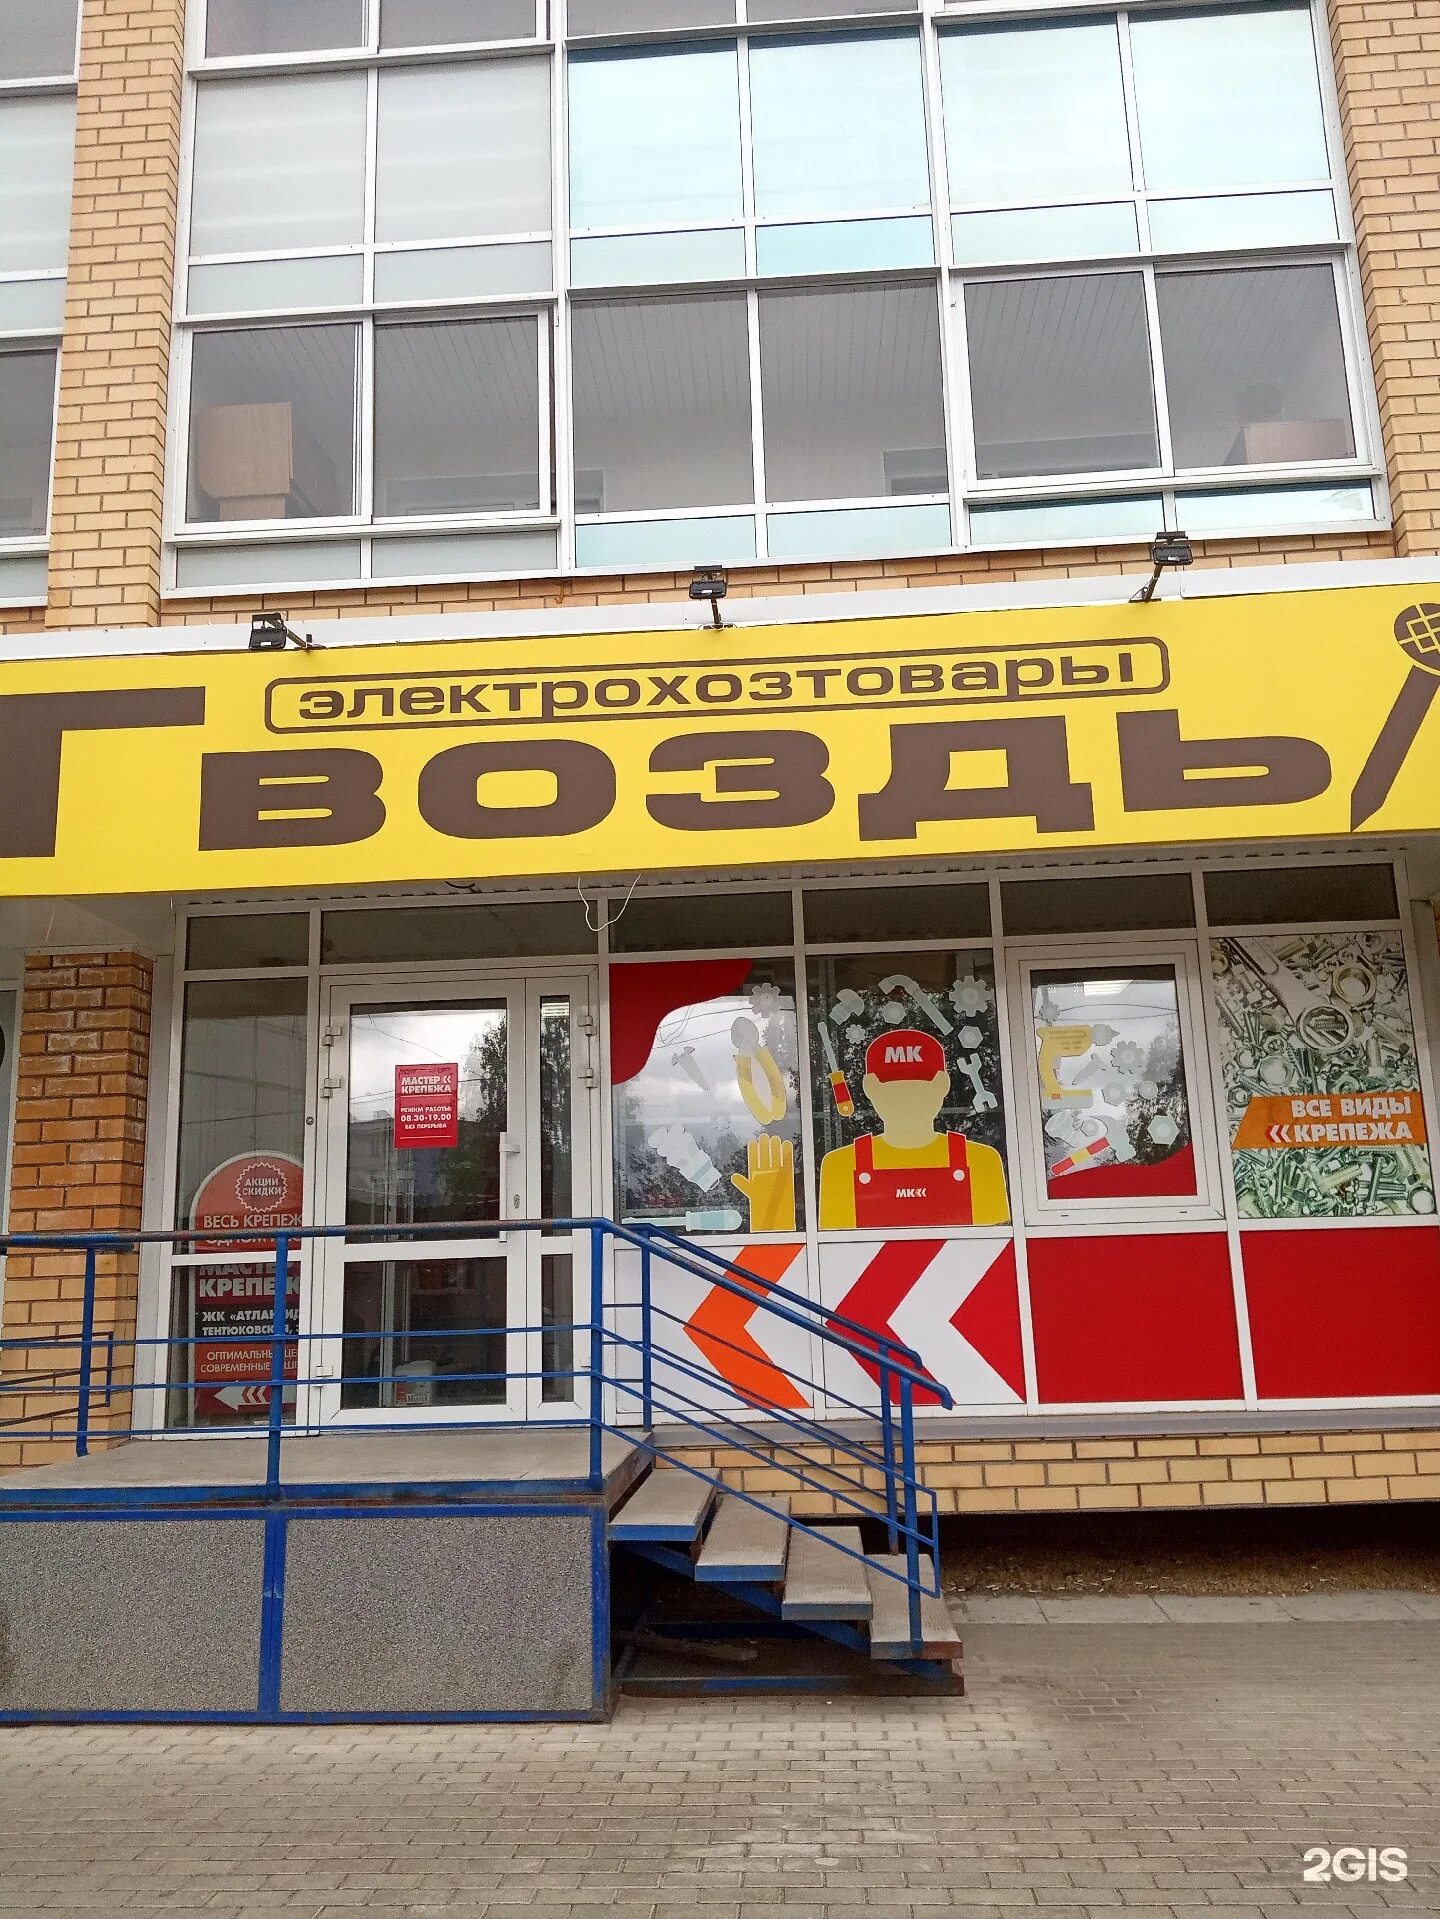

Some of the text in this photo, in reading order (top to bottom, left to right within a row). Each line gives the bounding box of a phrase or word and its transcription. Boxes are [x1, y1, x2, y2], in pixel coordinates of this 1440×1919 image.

[298, 651, 1133, 721] электрохозтовары
[884, 1046, 924, 1064] МК
[401, 1076, 441, 1086] МАСТЕР
[401, 1085, 452, 1094] КРЕПЕЖА
[1290, 1096, 1412, 1120] ВСЕ ВИДЫ
[400, 1113, 452, 1122] 08.30-19.00
[1293, 1121, 1414, 1143] КРЕПЕЖА
[245, 1178, 279, 1187] АКЦИИ
[242, 1186, 282, 1197] СКИДКИ
[203, 1213, 302, 1229] ВЕСЬ КРЕПЕЖ
[202, 1311, 226, 1322] ЖК
[201, 1362, 271, 1373] СОВРЕМЕННЫЕ
